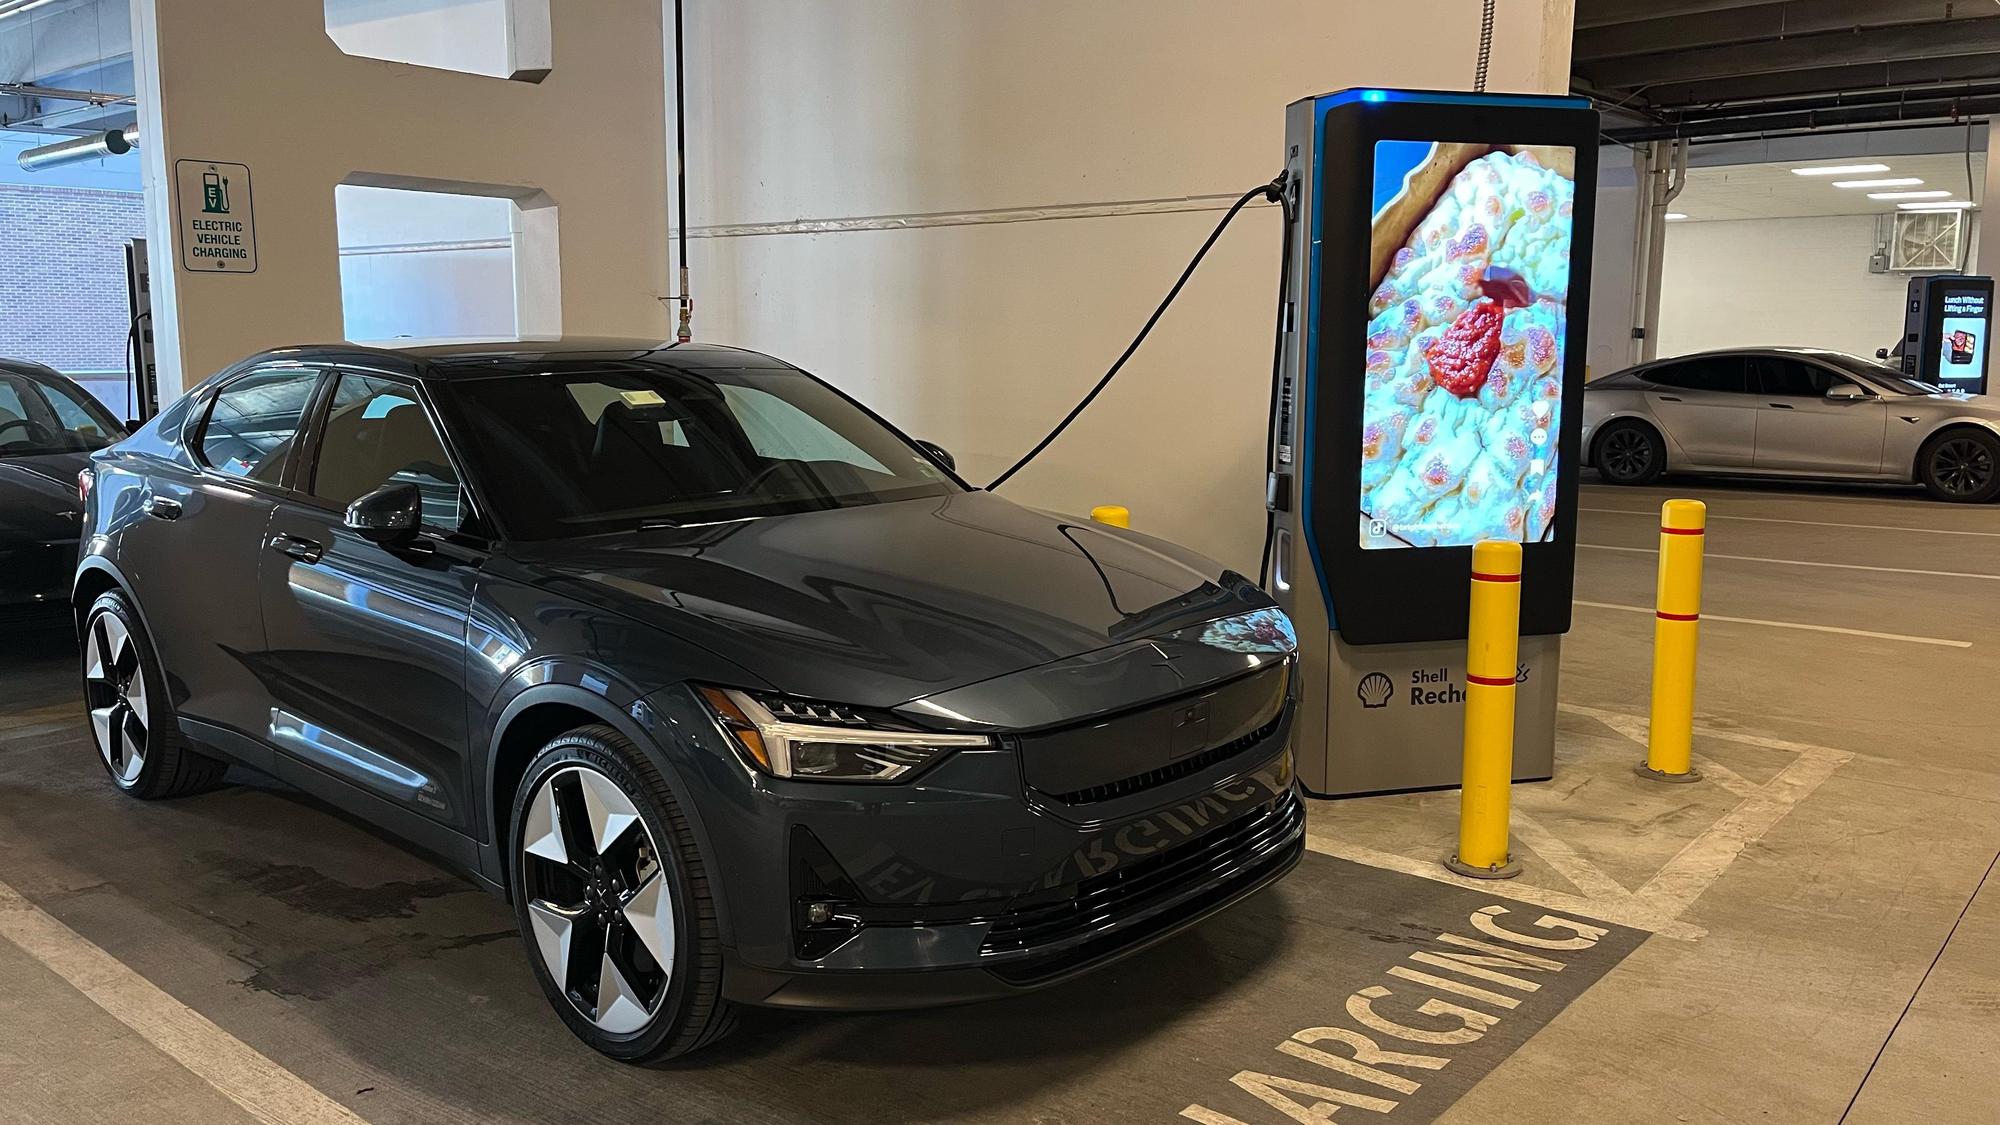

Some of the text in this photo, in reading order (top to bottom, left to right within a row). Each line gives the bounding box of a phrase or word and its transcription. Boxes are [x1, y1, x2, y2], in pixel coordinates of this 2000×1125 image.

[208, 187, 217, 208] EV
[192, 220, 242, 232] ELECTRIC
[197, 234, 241, 245] VEHICLE
[192, 247, 247, 258] CHARGING
[1944, 296, 1984, 304] Lunch Without
[1944, 305, 1962, 314] Lifting
[1966, 305, 1984, 314] Finger
[1412, 668, 1448, 683] Shell
[1178, 905, 1610, 1125] ARGING
